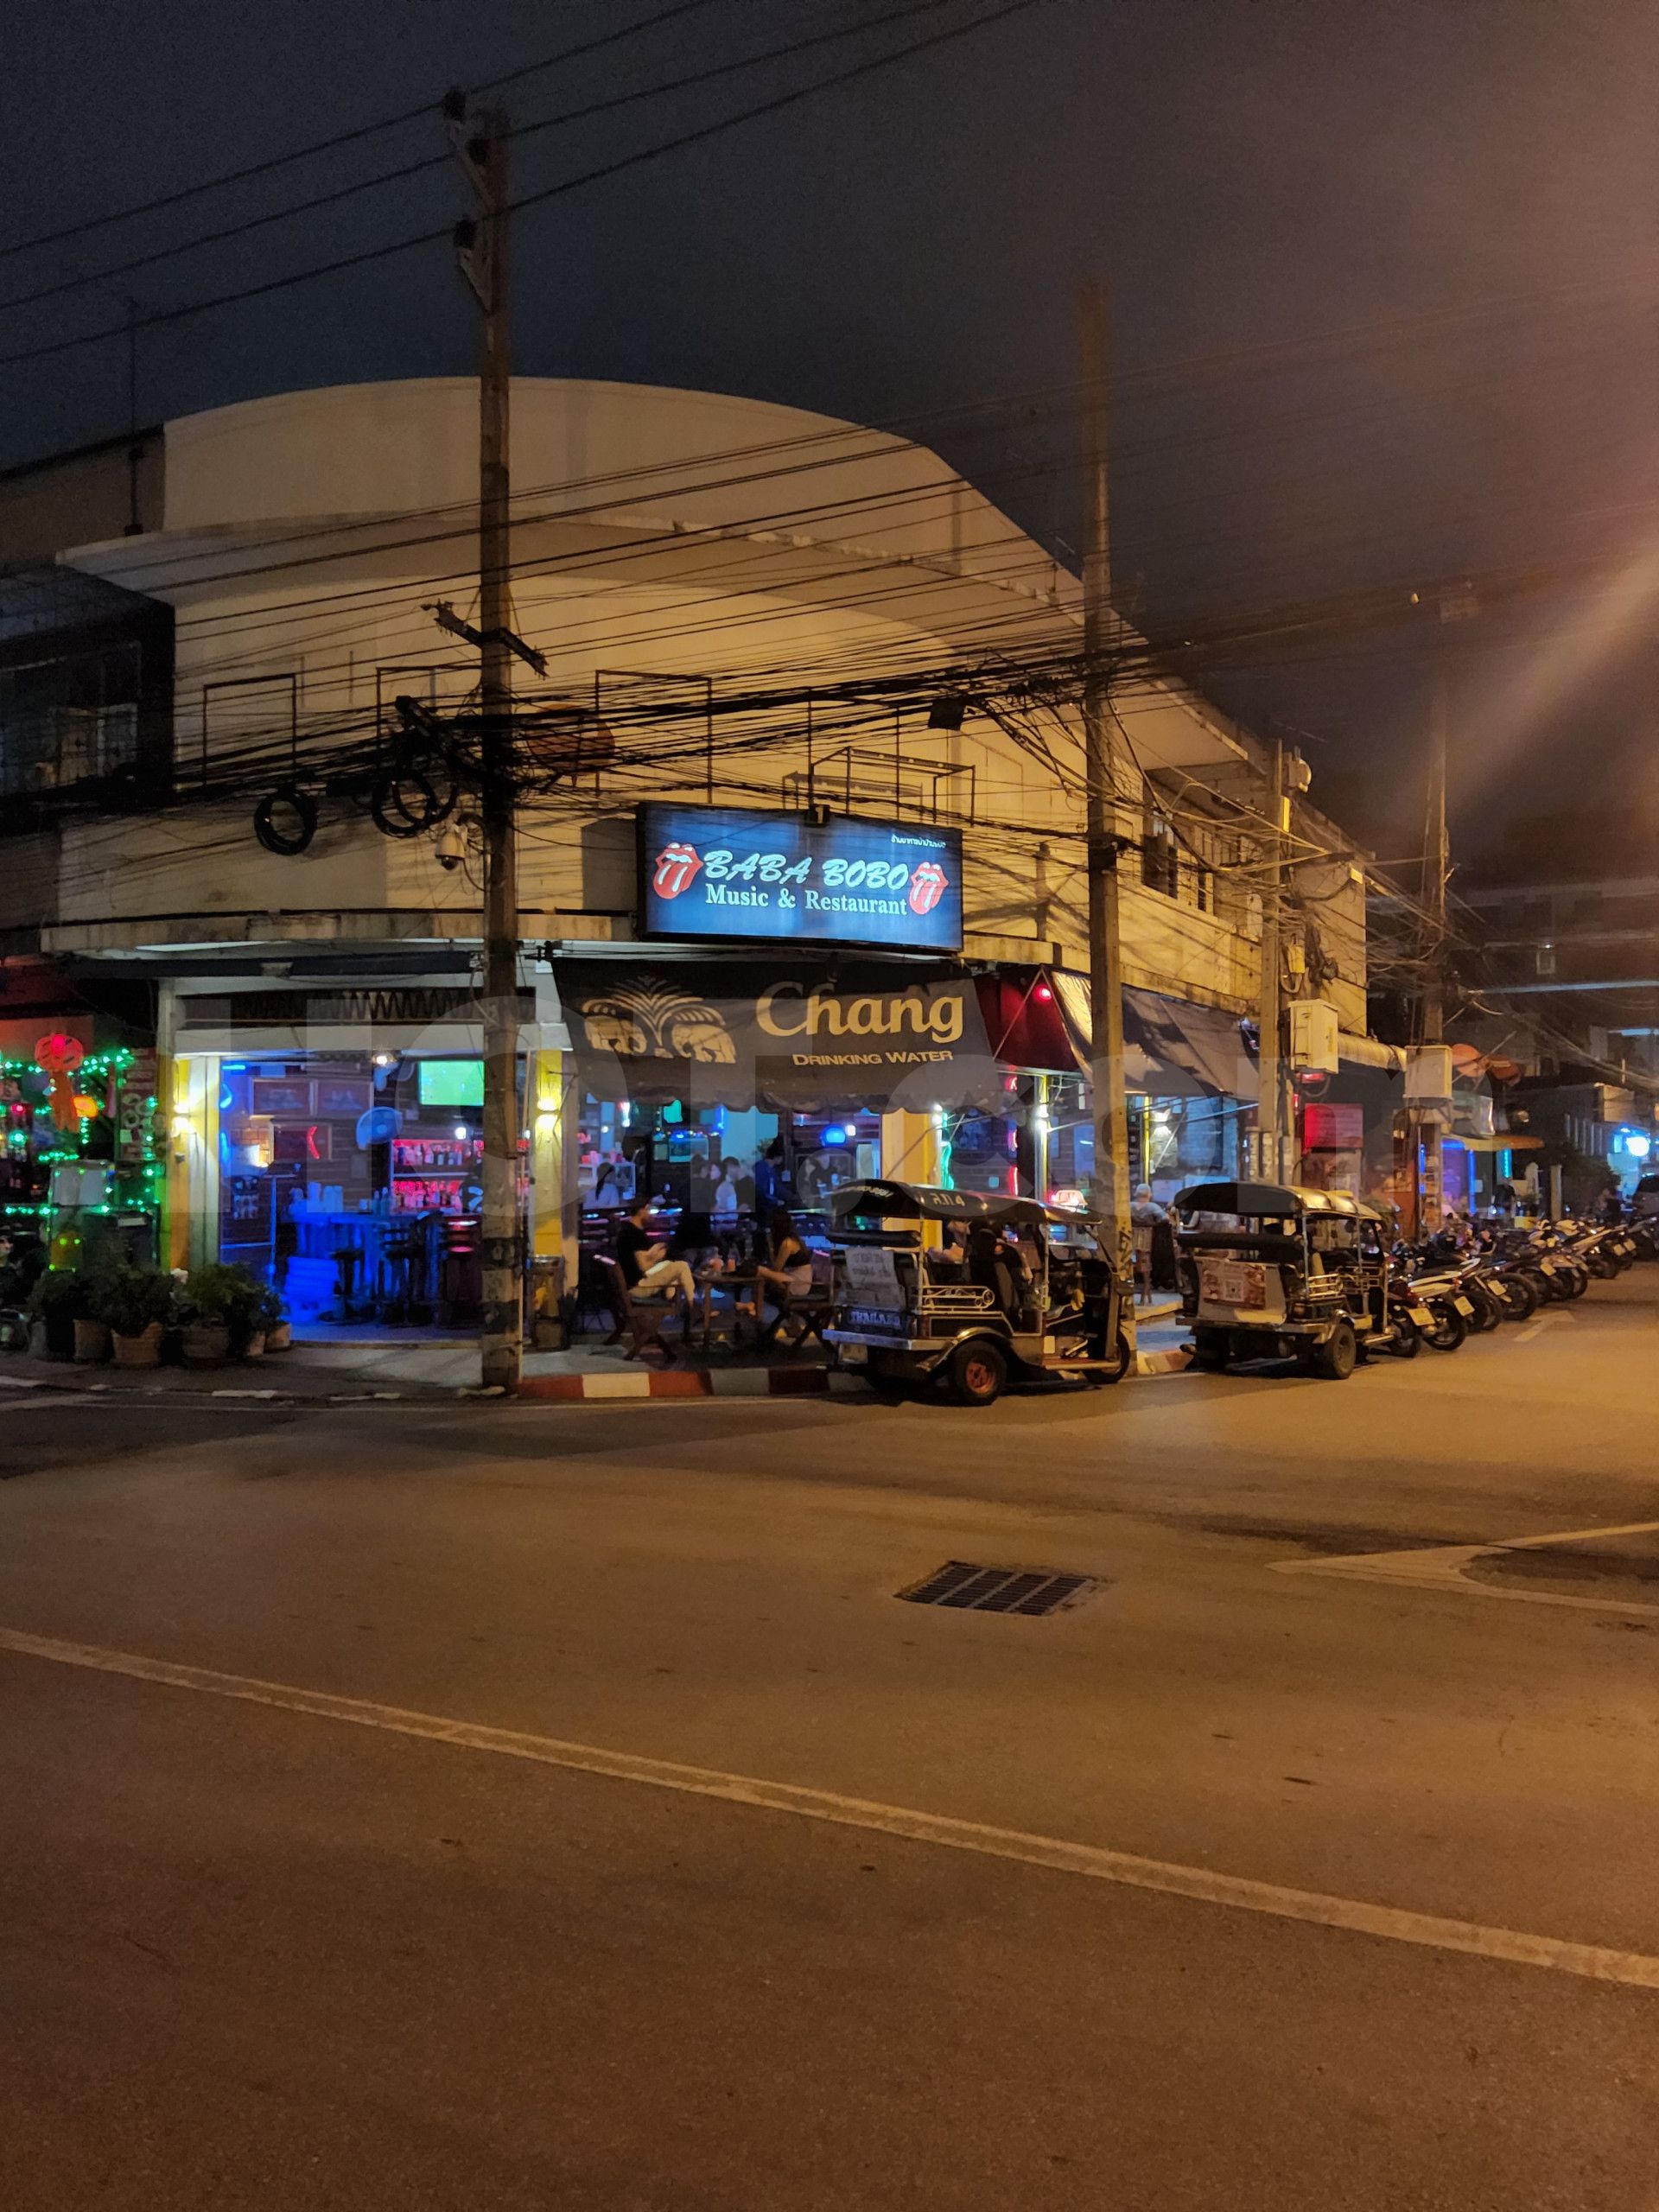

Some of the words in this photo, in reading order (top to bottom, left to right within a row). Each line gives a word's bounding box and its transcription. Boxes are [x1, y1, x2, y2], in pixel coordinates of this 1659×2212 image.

[703, 849, 811, 883] BABA
[822, 858, 909, 890] BOBO
[705, 883, 769, 906] Music
[778, 888, 796, 909] &
[804, 889, 907, 916] Restaurant
[755, 981, 963, 1043] Chang
[792, 1050, 882, 1067] DRINKING
[886, 1049, 954, 1065] WATER
